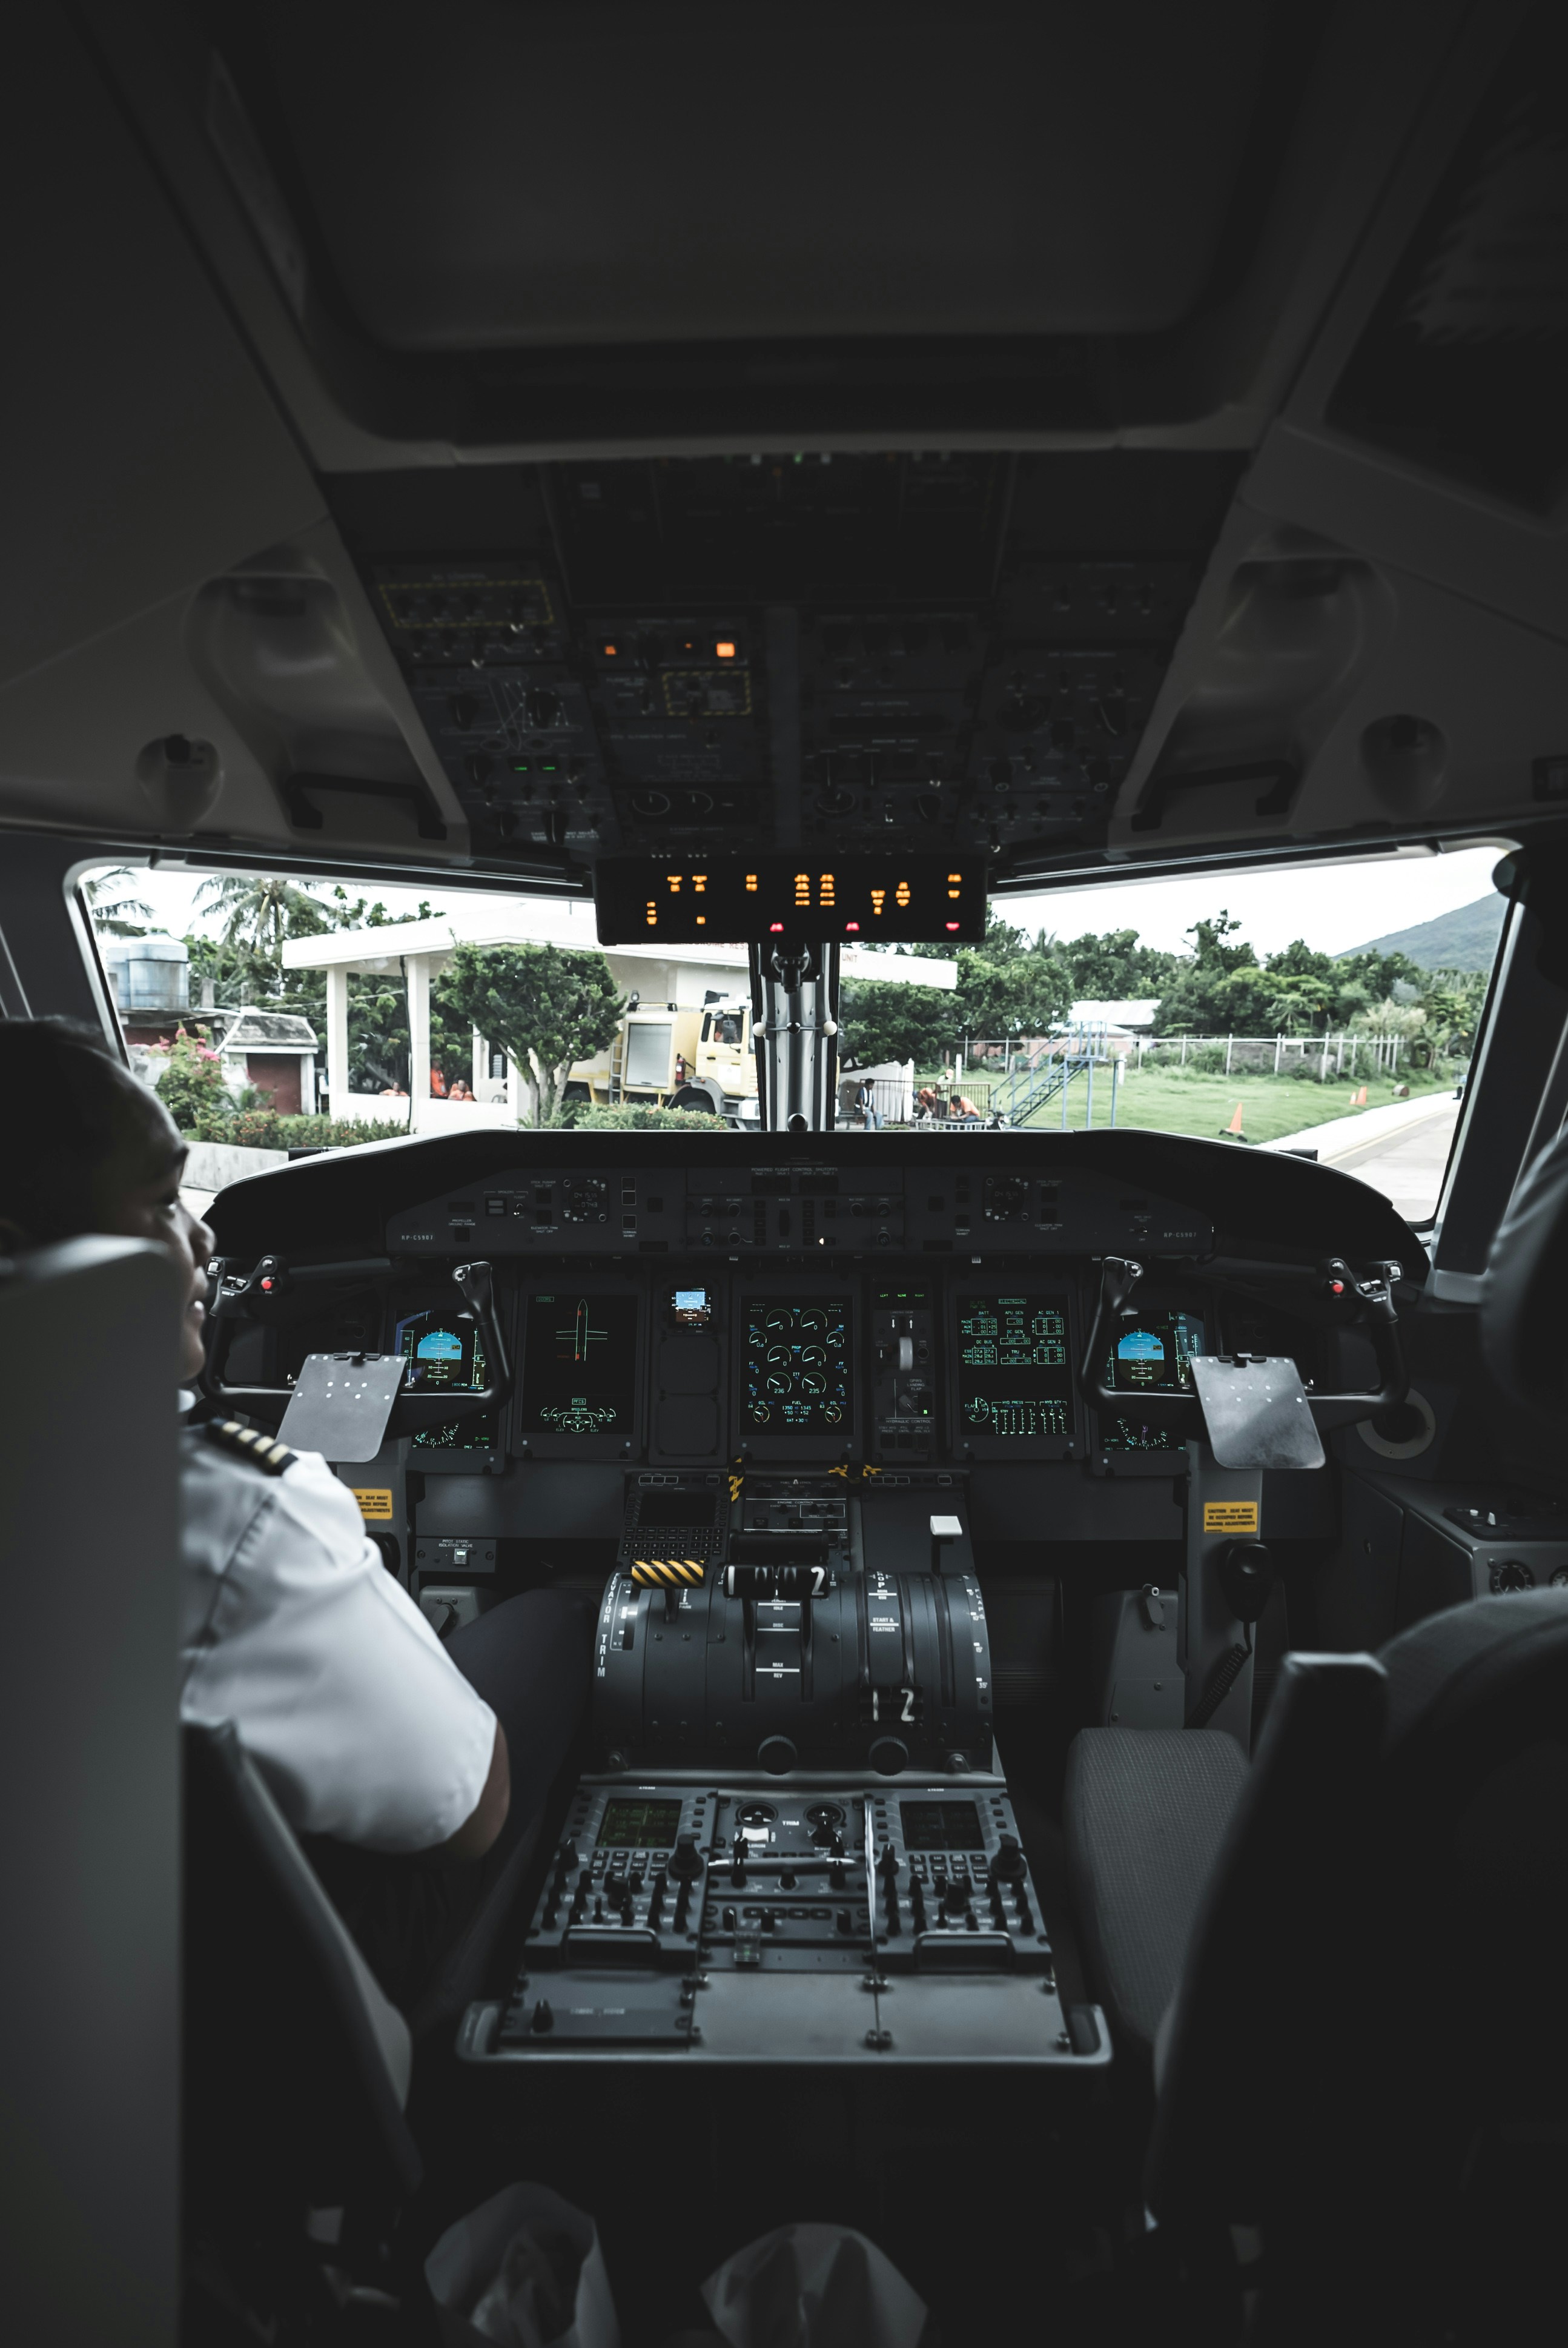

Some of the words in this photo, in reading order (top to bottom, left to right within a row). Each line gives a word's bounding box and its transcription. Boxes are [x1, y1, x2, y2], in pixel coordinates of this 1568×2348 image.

[842, 953, 857, 963] UNIT
[728, 1566, 735, 1595] 1
[810, 1567, 825, 1596] 2
[597, 1634, 608, 1677] TRIM
[873, 1688, 879, 1722] 1
[901, 1688, 915, 1722] 2
